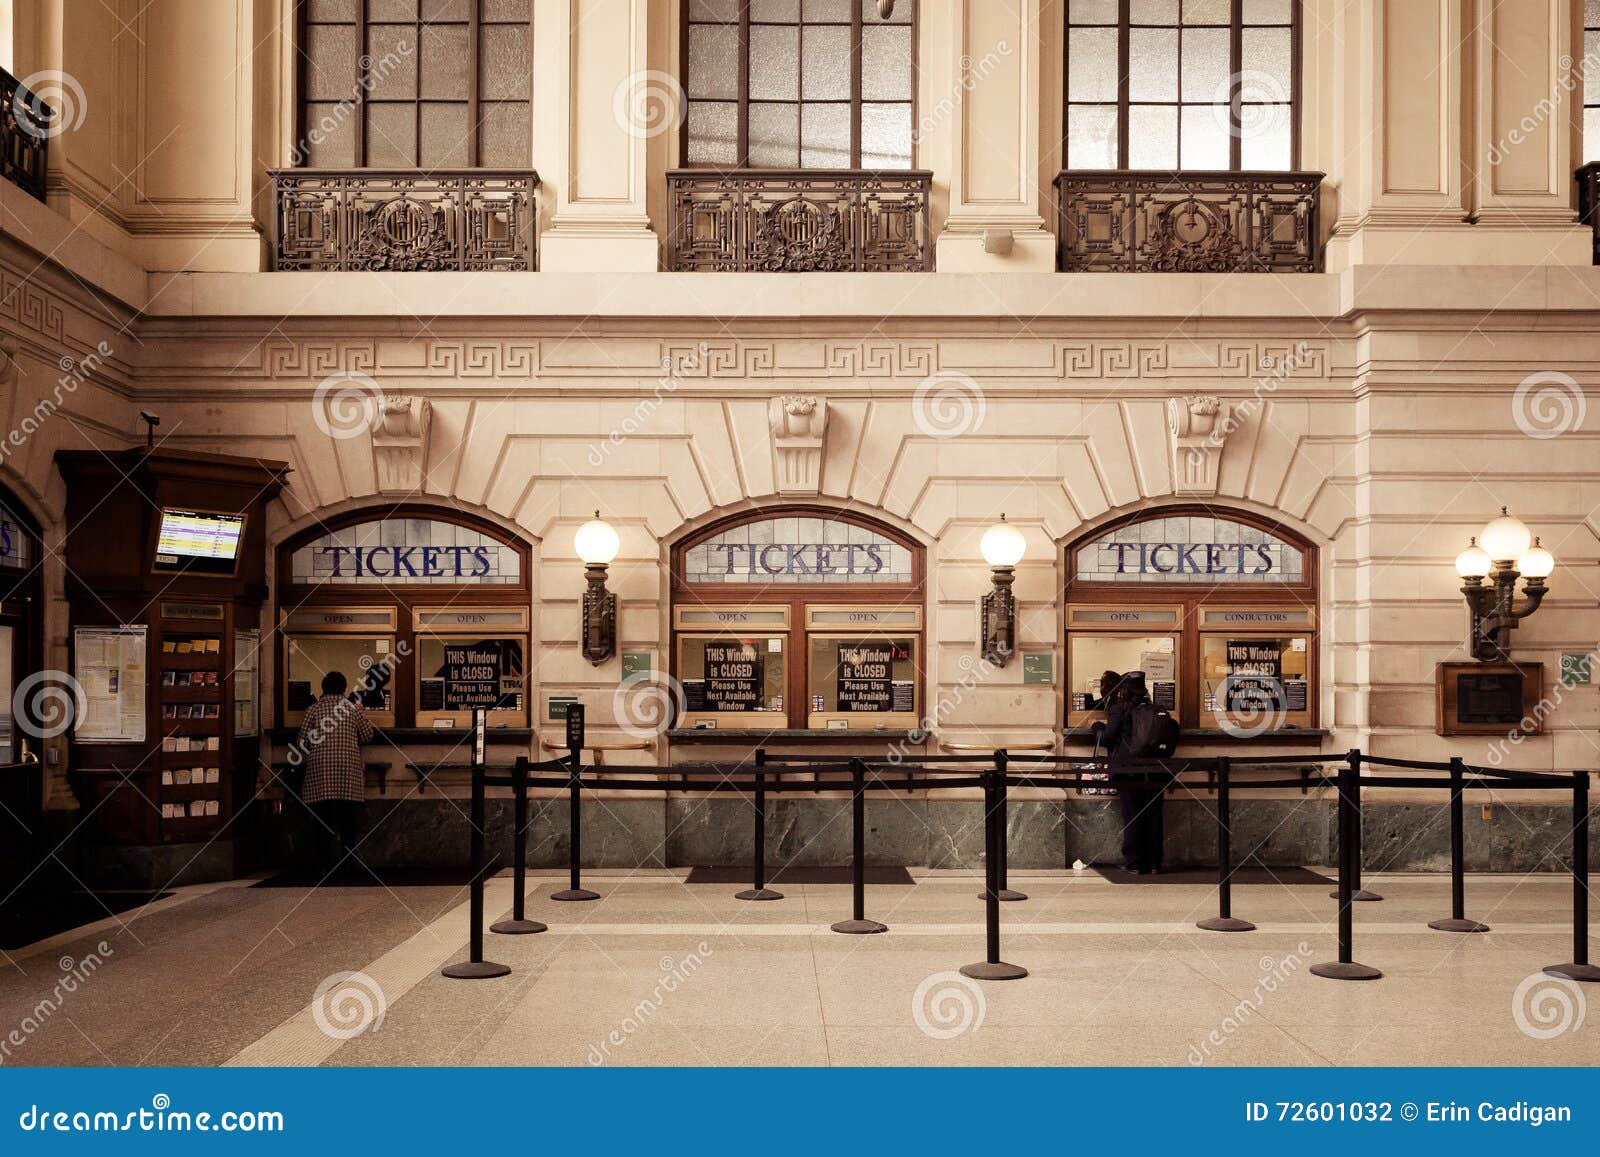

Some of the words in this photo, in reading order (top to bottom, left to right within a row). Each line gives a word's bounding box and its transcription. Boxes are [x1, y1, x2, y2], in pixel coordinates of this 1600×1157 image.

[322, 546, 491, 577] TICKETS
[716, 543, 883, 575] TICKETS
[1107, 543, 1273, 575] TICKETS
[324, 615, 354, 623] OPEN
[457, 615, 486, 623] OPEN
[718, 613, 747, 621] OPEN
[849, 613, 878, 621] OPEN
[1110, 613, 1139, 621] OPEN
[1224, 613, 1288, 621] CONDUCTORS
[446, 651, 465, 664] THIS
[467, 651, 497, 664] Window
[706, 648, 725, 662] THIS
[726, 648, 757, 662] Window
[839, 649, 858, 662] THIS
[860, 649, 891, 662] Window
[1229, 647, 1248, 660] THIS
[1249, 647, 1280, 660] Window
[451, 667, 459, 680] is
[461, 666, 494, 680] CLOSED
[710, 664, 718, 678] is
[720, 664, 753, 678] CLOSED
[844, 665, 851, 678] is
[854, 664, 886, 678] CLOSED
[1243, 662, 1275, 676] CLOSED
[452, 684, 476, 693] Please
[478, 684, 492, 693] Use
[711, 681, 735, 690] Please
[737, 681, 751, 690] Use
[844, 681, 869, 690] Please
[871, 681, 885, 690] Use
[1234, 680, 1258, 689] Please
[1260, 680, 1274, 689] Use
[447, 694, 464, 703] Next
[466, 694, 497, 703] Available
[706, 691, 723, 700] Next
[725, 691, 756, 700] Available
[840, 692, 856, 701] Next
[858, 692, 890, 701] Available
[1229, 690, 1245, 699] Next
[1247, 690, 1279, 699] Available
[717, 701, 745, 711] Window
[851, 701, 879, 711] Window
[1240, 699, 1268, 709] Window
